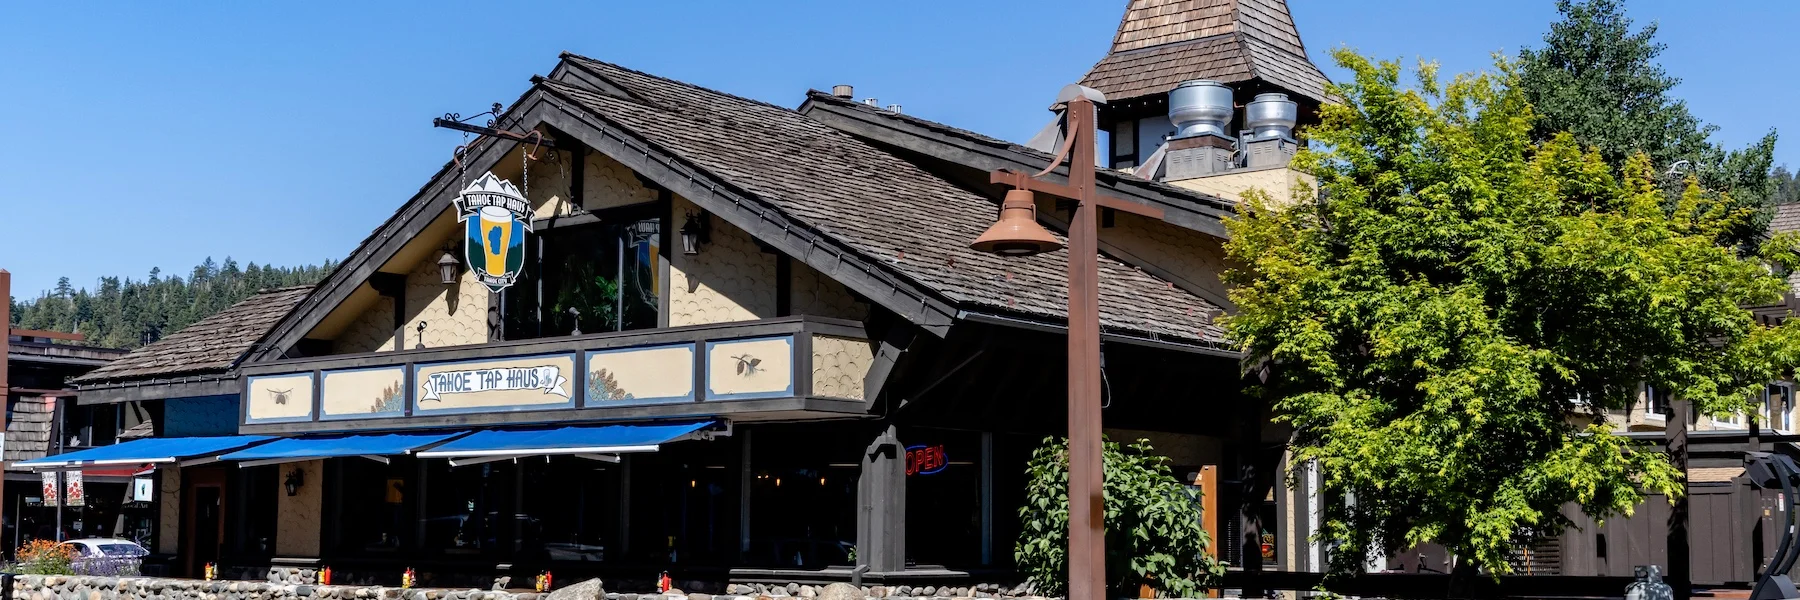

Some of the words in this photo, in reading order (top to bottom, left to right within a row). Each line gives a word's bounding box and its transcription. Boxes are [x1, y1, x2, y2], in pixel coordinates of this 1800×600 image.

[466, 194, 491, 206] TAHOE
[492, 195, 505, 207] TAP
[506, 199, 525, 213] HAUS
[431, 372, 472, 392] TAHOE
[476, 370, 502, 389] TAP
[506, 368, 539, 388] HAUS
[905, 445, 943, 475] OPEN
